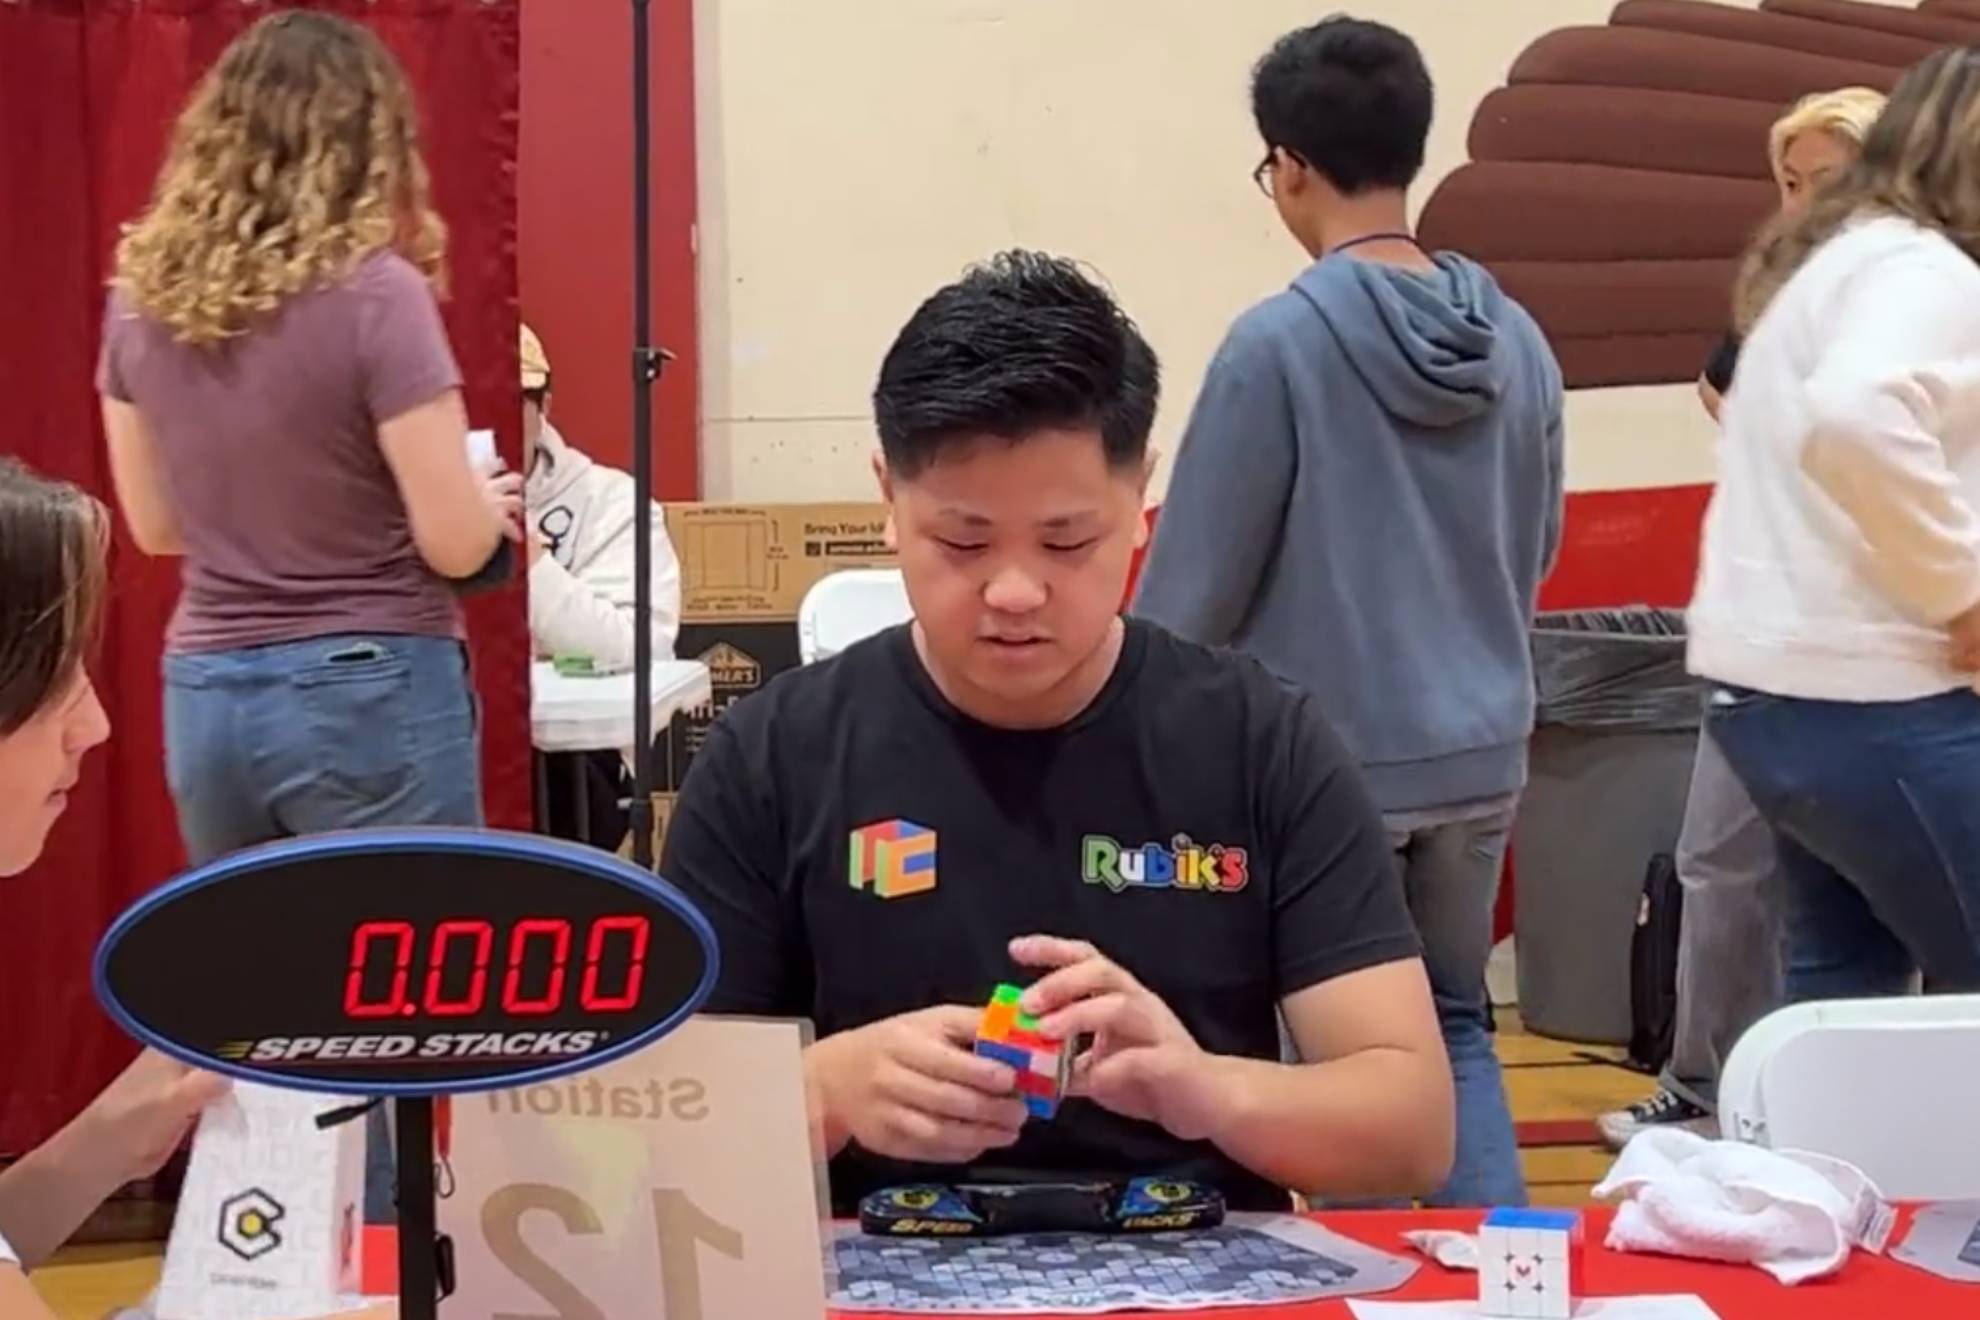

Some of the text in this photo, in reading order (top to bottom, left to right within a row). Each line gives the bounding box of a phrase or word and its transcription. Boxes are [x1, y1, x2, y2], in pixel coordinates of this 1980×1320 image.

[1082, 833, 1249, 893] Rubik's
[346, 916, 649, 1015] 0.000
[250, 1036, 416, 1061] SPEED
